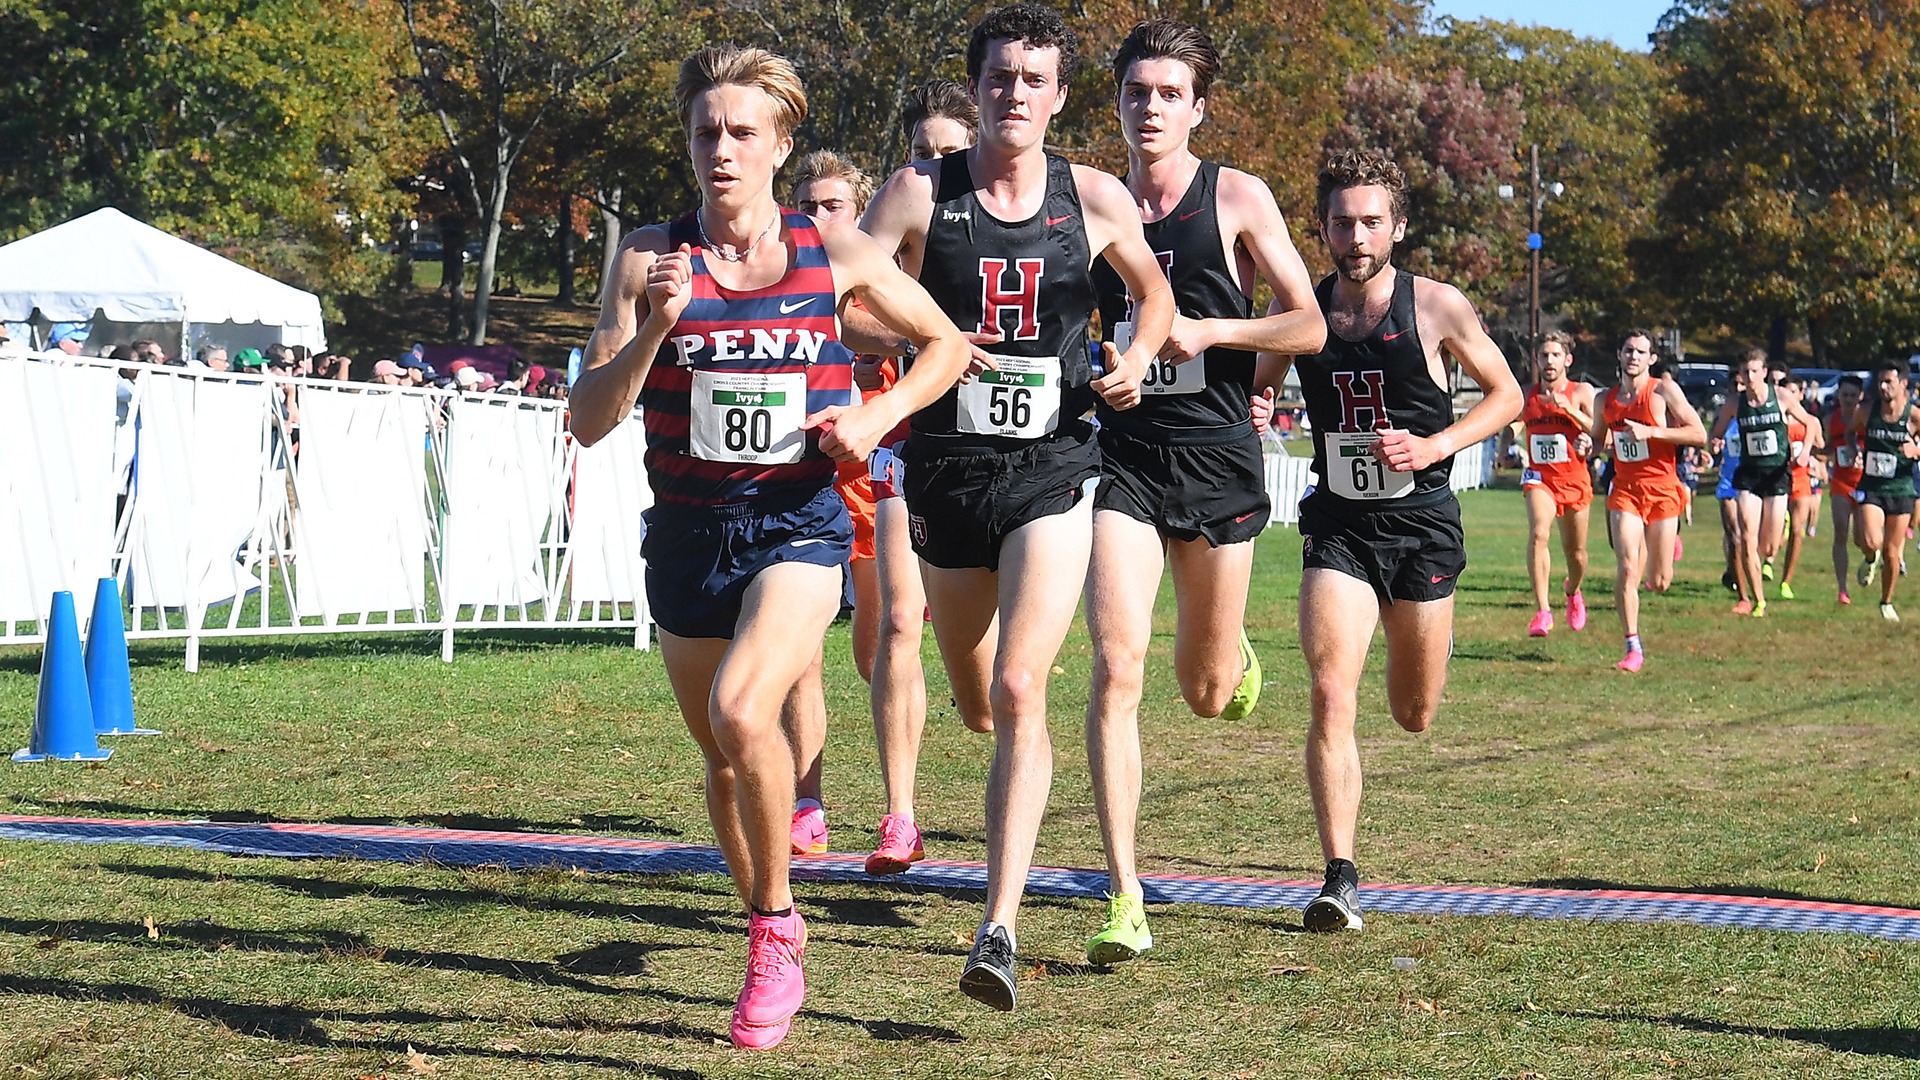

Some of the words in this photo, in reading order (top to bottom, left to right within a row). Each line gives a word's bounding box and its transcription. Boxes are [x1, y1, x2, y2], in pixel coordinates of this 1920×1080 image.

[943, 210, 961, 222] Ivy
[977, 257, 1044, 342] H
[670, 328, 827, 366] PENN
[999, 372, 1016, 384] Ivy
[735, 392, 754, 405] Ivy
[989, 386, 1031, 428] 56
[1332, 370, 1393, 433] H
[725, 408, 771, 453] 80
[1356, 446, 1369, 455] Ivy
[1540, 446, 1556, 460] 89
[1622, 443, 1638, 458] 90
[1351, 457, 1386, 491] 61
